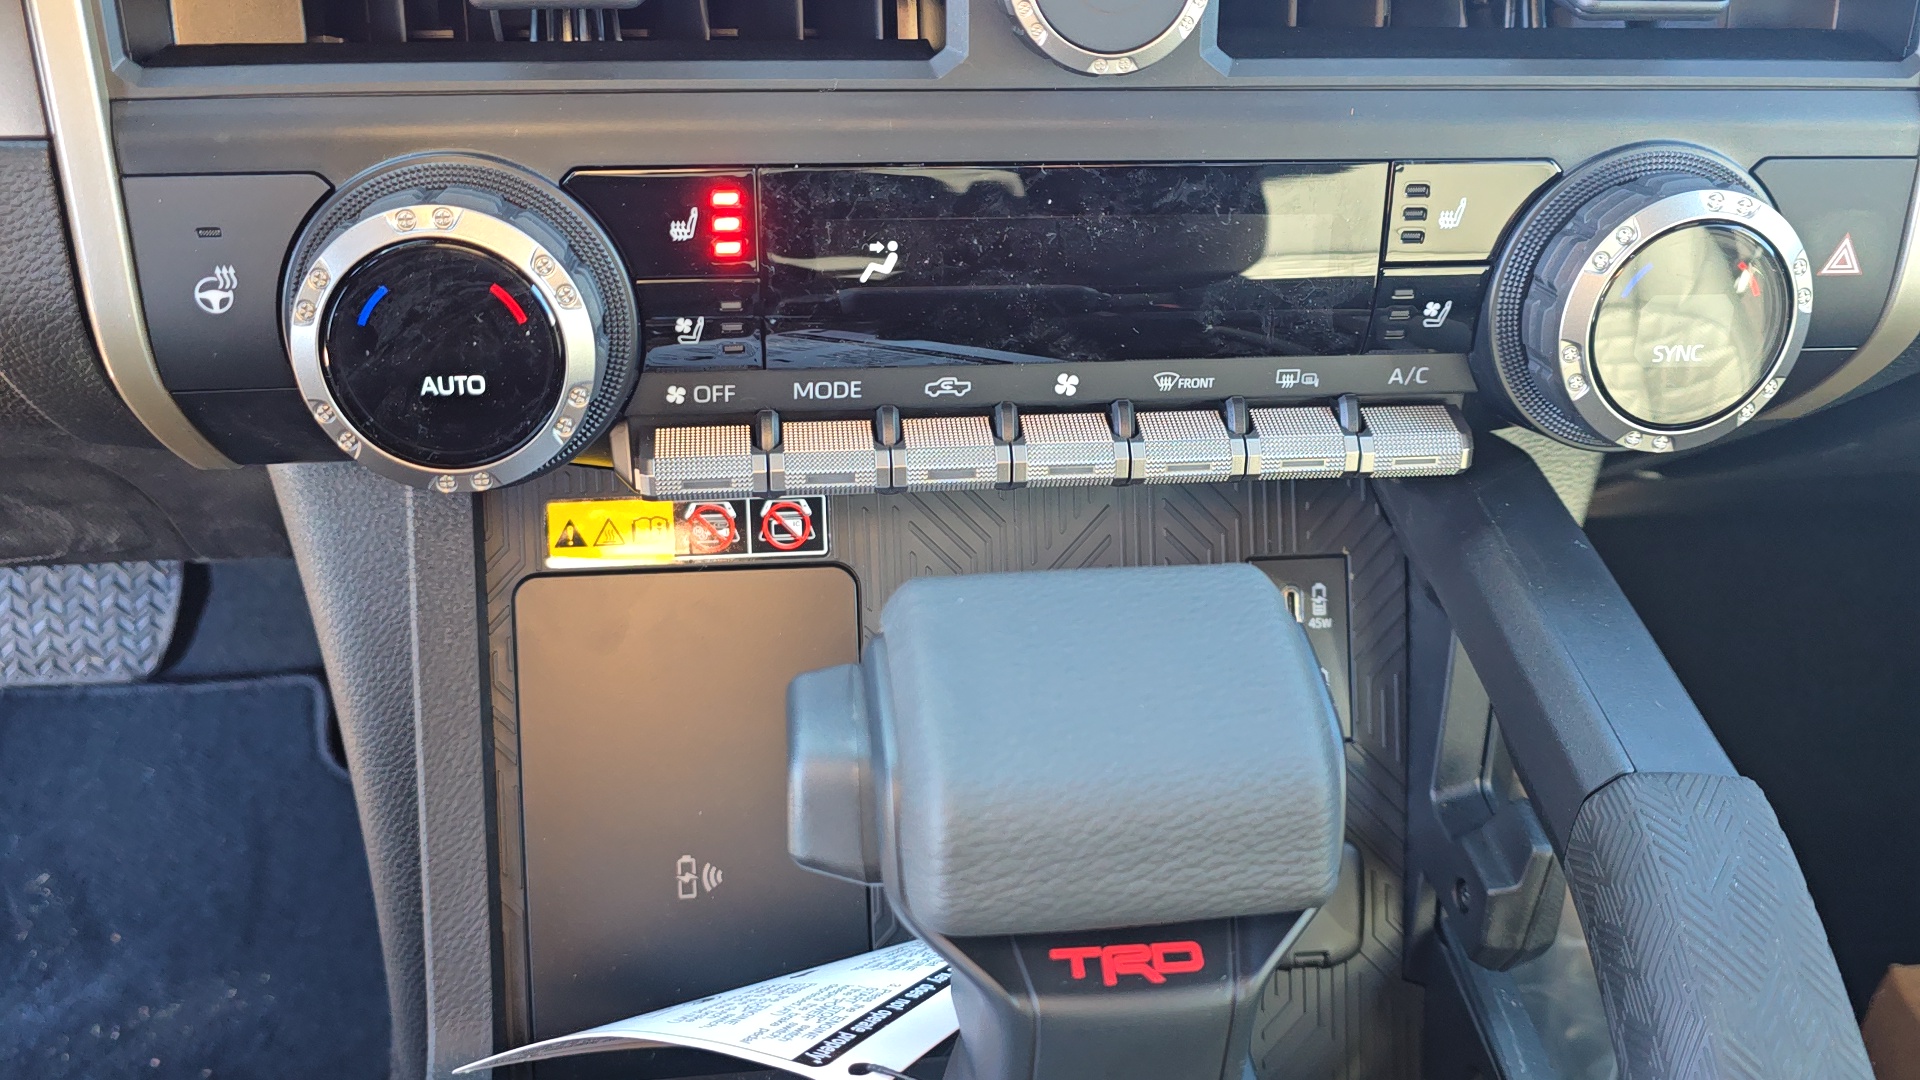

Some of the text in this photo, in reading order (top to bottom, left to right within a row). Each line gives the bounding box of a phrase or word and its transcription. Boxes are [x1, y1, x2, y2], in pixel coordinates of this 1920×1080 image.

[1652, 344, 1705, 363] SYNC
[420, 374, 486, 396] AUTO
[1178, 377, 1215, 389] FRONT
[1388, 366, 1430, 386] A/C
[693, 384, 736, 403] OFF
[793, 380, 862, 400] MODE
[1308, 617, 1333, 629] 45W
[1048, 940, 1205, 987] TRD
[905, 983, 936, 999] does
[886, 998, 911, 1011] not
[851, 1009, 893, 1033] operate
